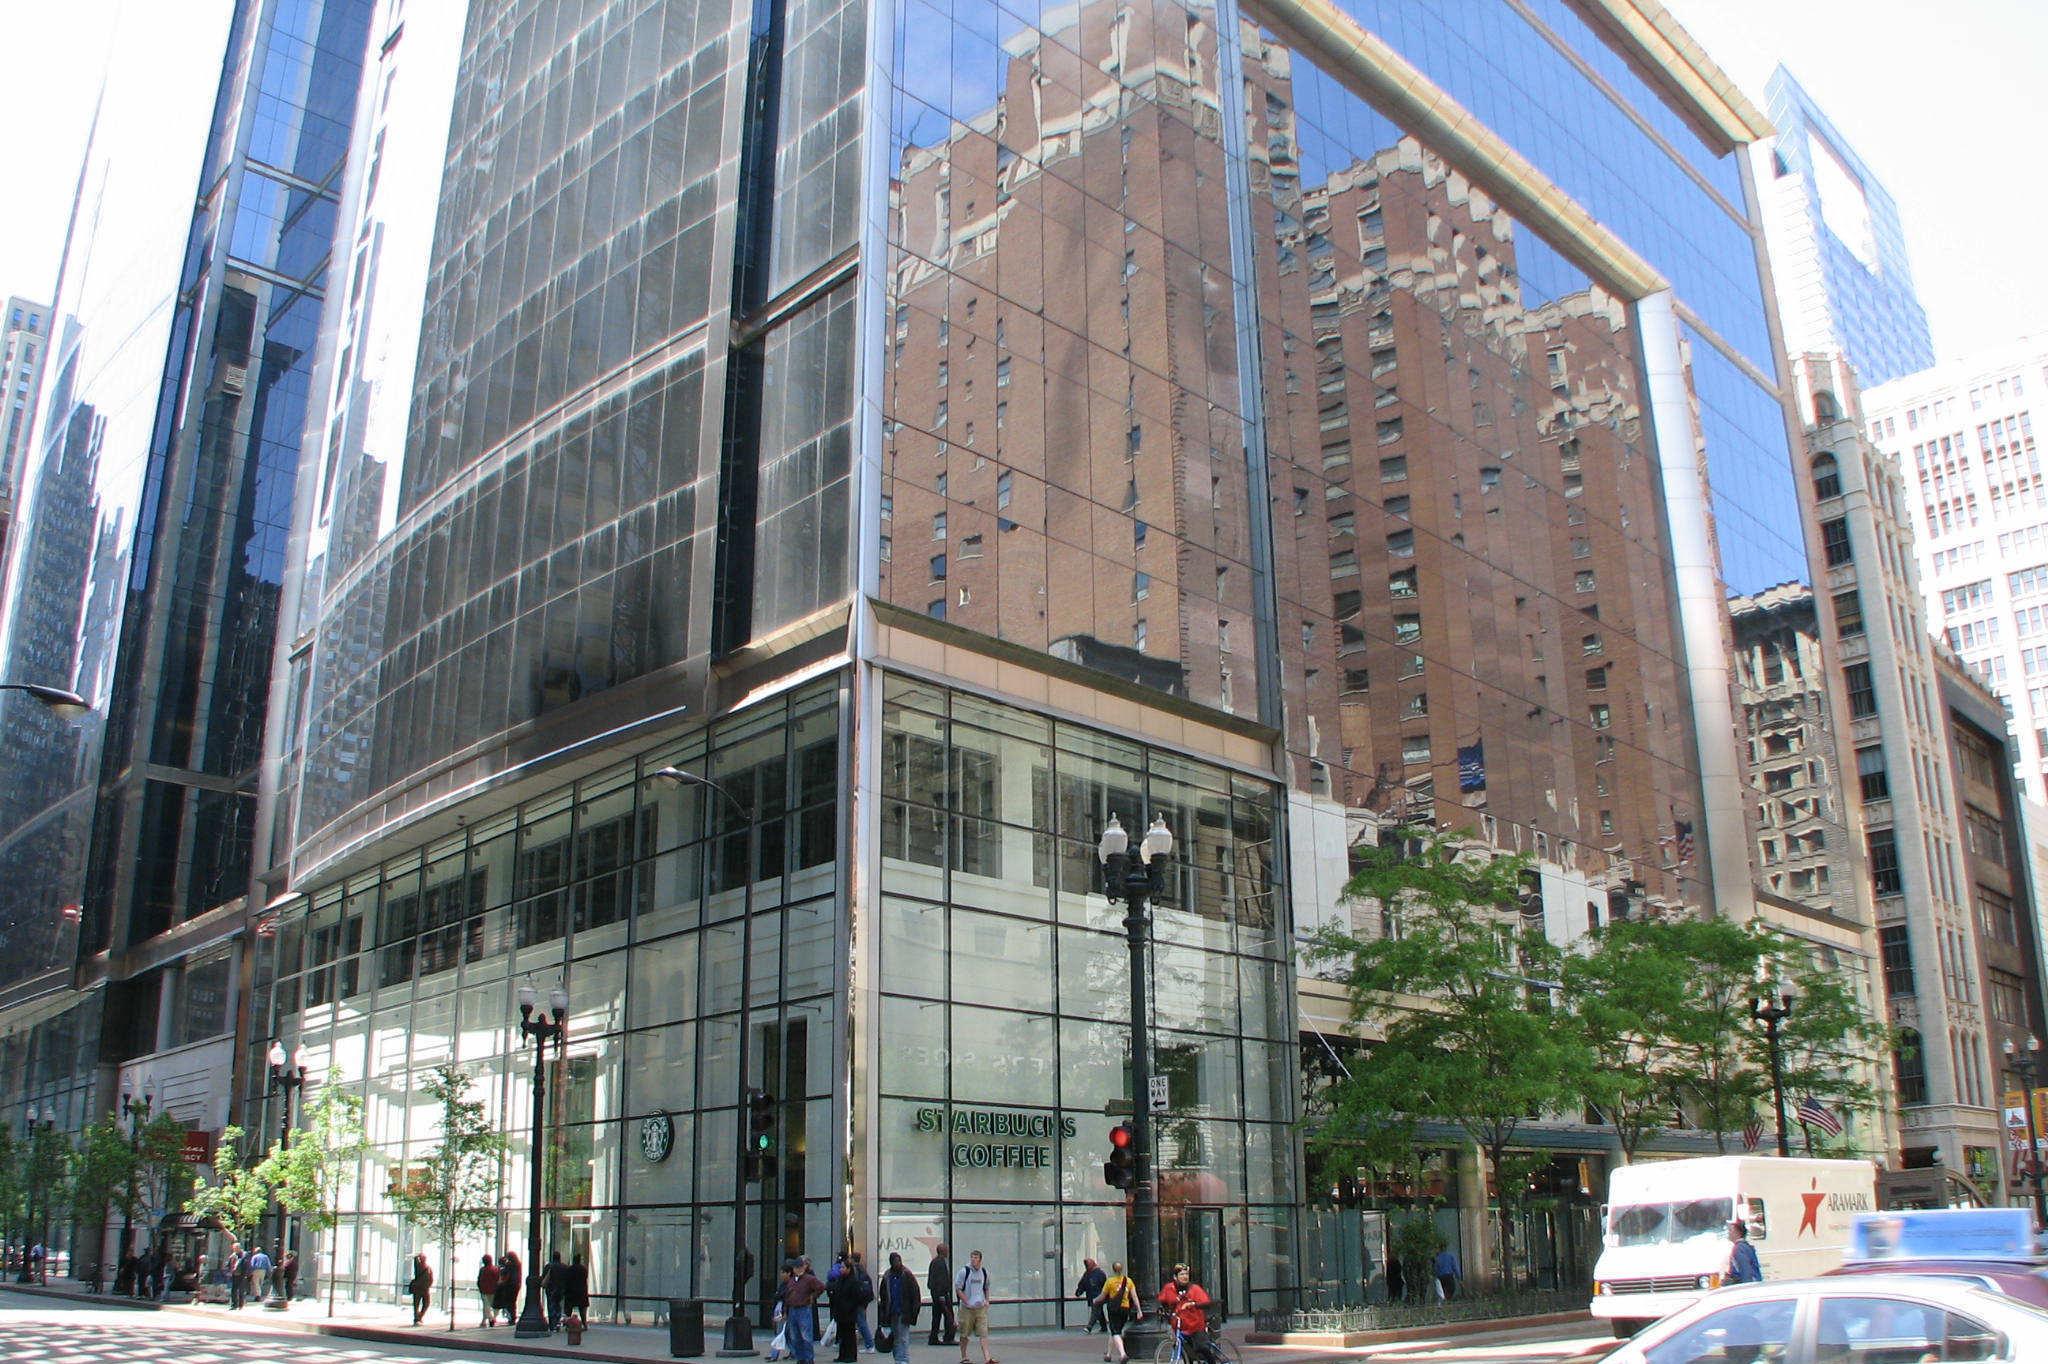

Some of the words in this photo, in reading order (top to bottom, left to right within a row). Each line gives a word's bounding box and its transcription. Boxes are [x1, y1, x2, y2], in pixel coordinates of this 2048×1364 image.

[1150, 1078, 1166, 1088] ONE
[1150, 1088, 1166, 1097] WAY
[952, 1143, 1051, 1168] COFFEE
[1828, 1192, 1869, 1211] ARAMARK
